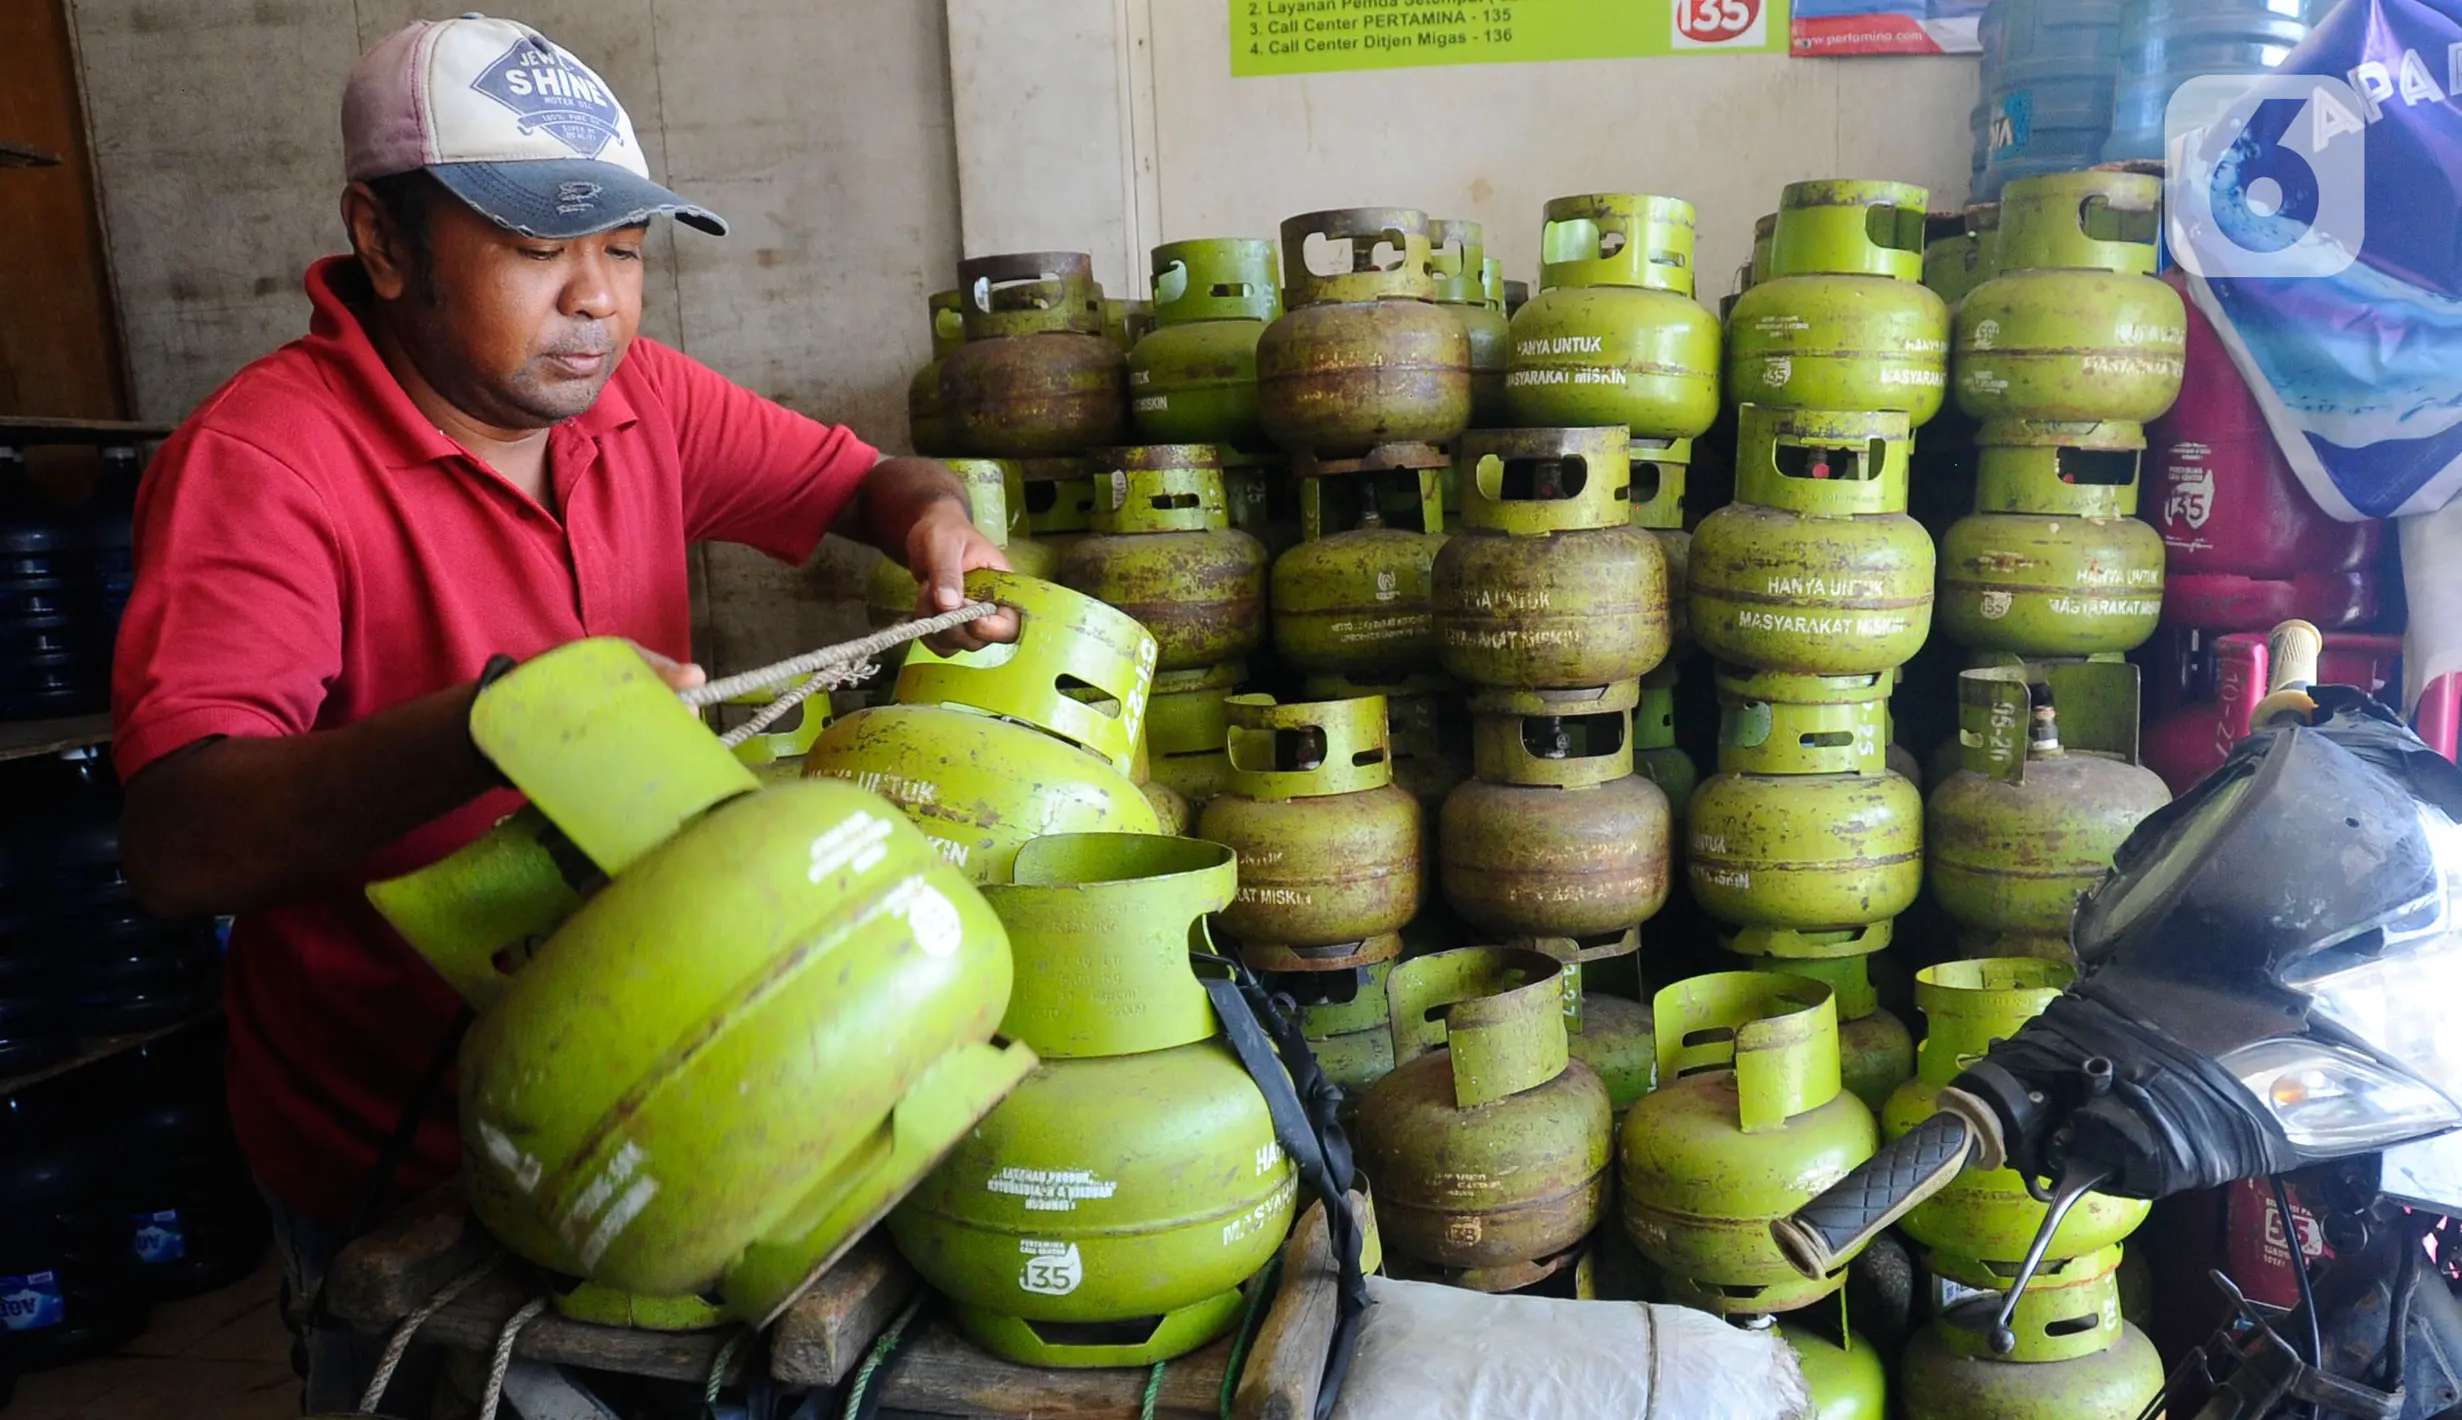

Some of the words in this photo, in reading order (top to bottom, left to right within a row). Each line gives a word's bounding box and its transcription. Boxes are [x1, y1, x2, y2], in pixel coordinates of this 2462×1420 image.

[1249, 2, 1262, 15] 2.
[1267, 0, 1336, 16] Layanan
[1249, 22, 1262, 36] 3.
[1268, 19, 1298, 34] Call
[1304, 17, 1358, 32] Center
[1363, 10, 1466, 28] PERTAMINA
[1483, 8, 1511, 23] 135
[1250, 42, 1263, 55] 4.
[1269, 39, 1299, 54] Call
[1305, 37, 1358, 52] Center
[1364, 33, 1412, 51] Ditjen
[1418, 31, 1466, 48] Migas
[1484, 28, 1512, 42] 136
[505, 68, 608, 108] SHINE
[1552, 336, 1602, 354] UNTUK
[1574, 368, 1627, 384] MISKIN
[1768, 576, 1826, 596] HANYA
[1739, 610, 1853, 635] MASYARAKAT
[1024, 1264, 1071, 1290] 135
